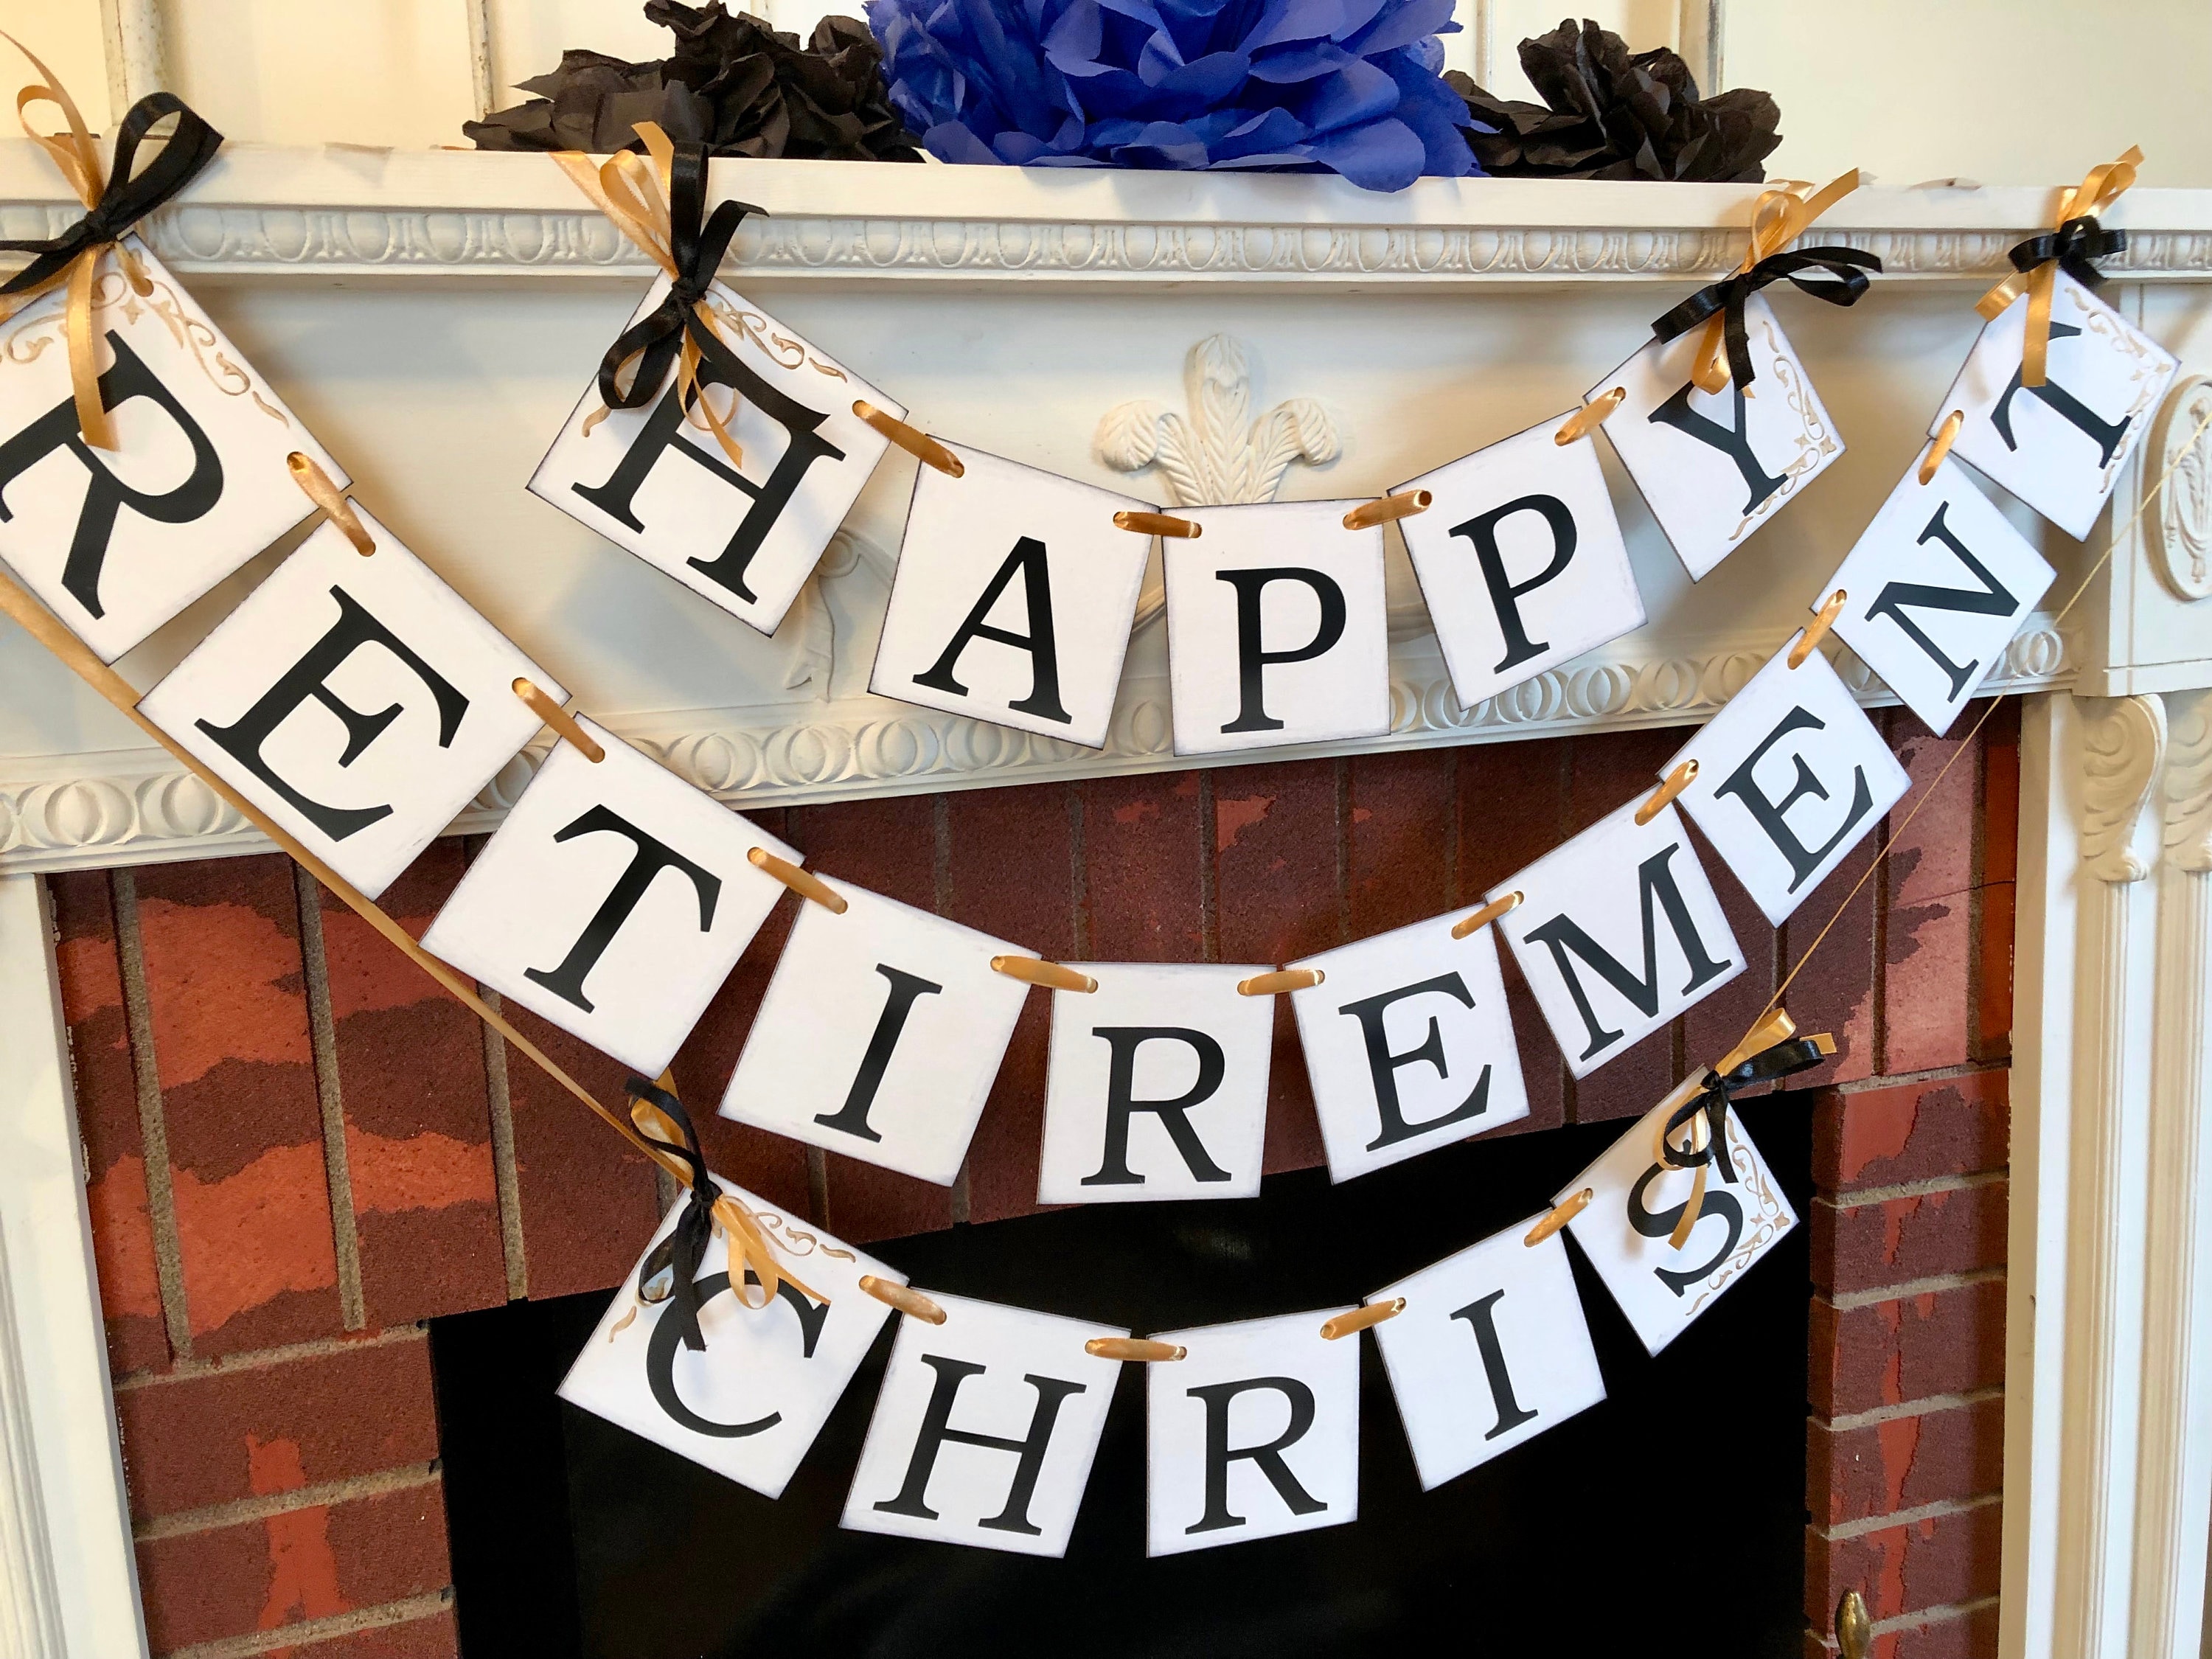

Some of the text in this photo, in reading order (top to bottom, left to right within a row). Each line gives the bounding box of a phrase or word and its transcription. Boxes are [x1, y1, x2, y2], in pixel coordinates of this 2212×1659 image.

[571, 342, 1790, 734] HAPPY
[0, 320, 2132, 1186] RETIREMENT
[646, 1139, 1744, 1537] CHRIS
